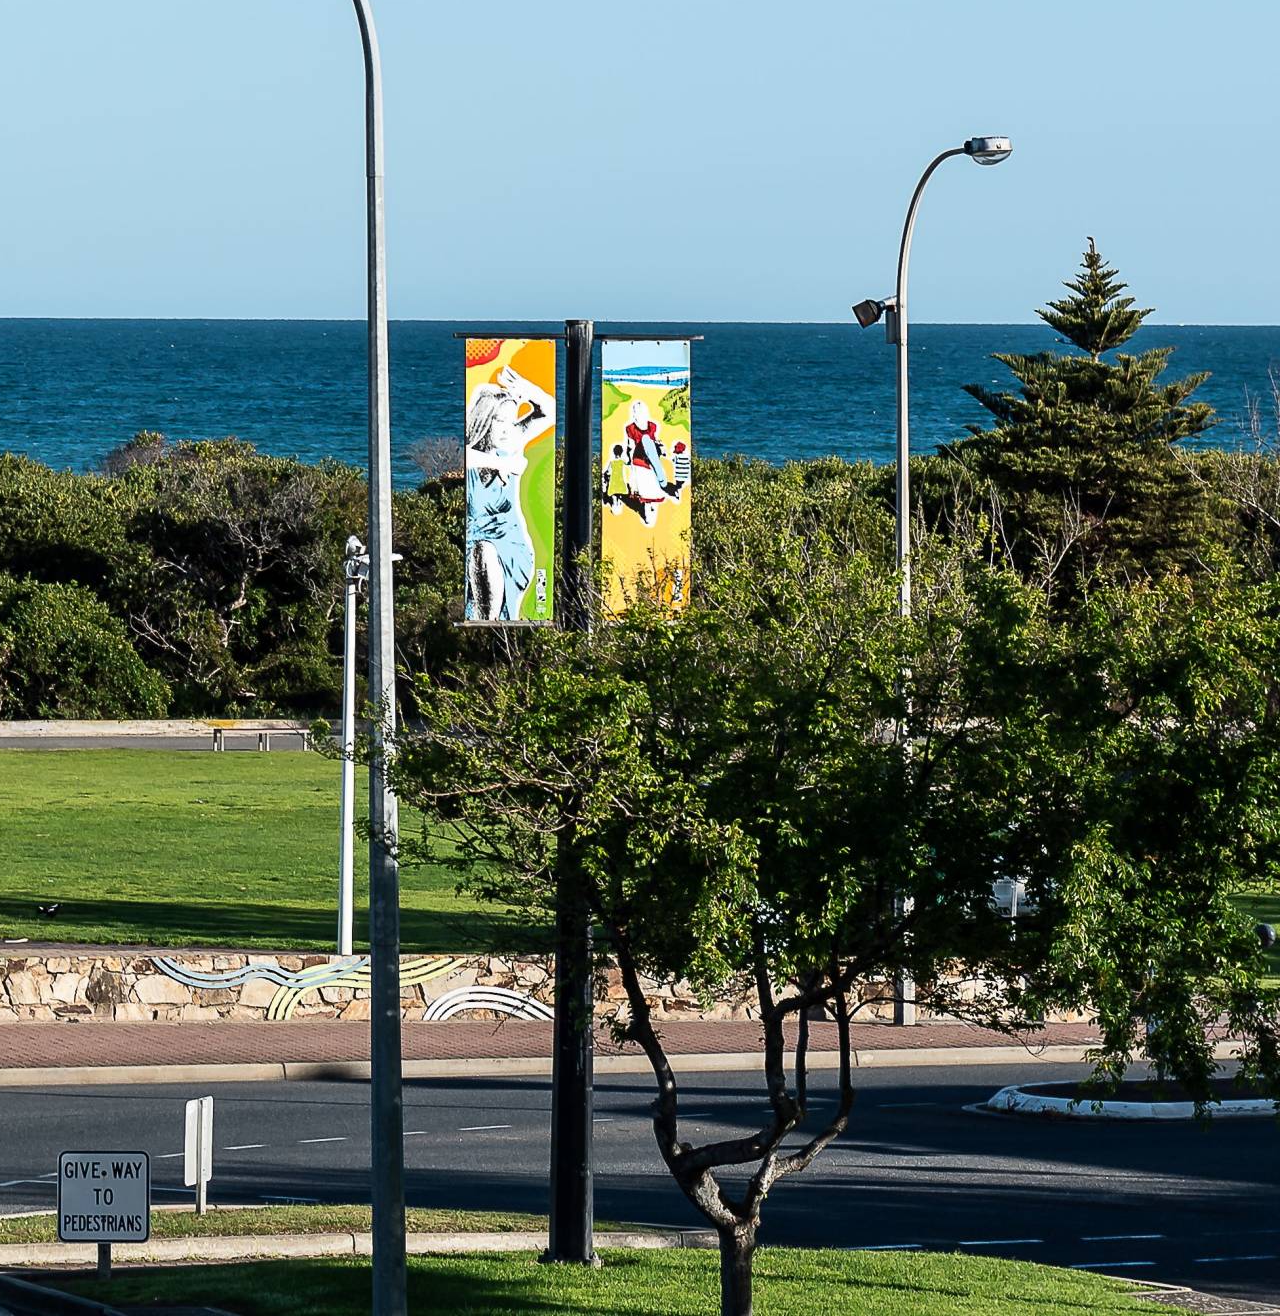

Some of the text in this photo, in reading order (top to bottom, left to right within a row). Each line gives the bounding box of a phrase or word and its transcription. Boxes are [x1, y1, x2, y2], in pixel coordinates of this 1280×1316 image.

[64, 1162, 142, 1179] GIVE WAY
[93, 1188, 114, 1205] TO
[63, 1214, 142, 1232] PEDESTRIANS
